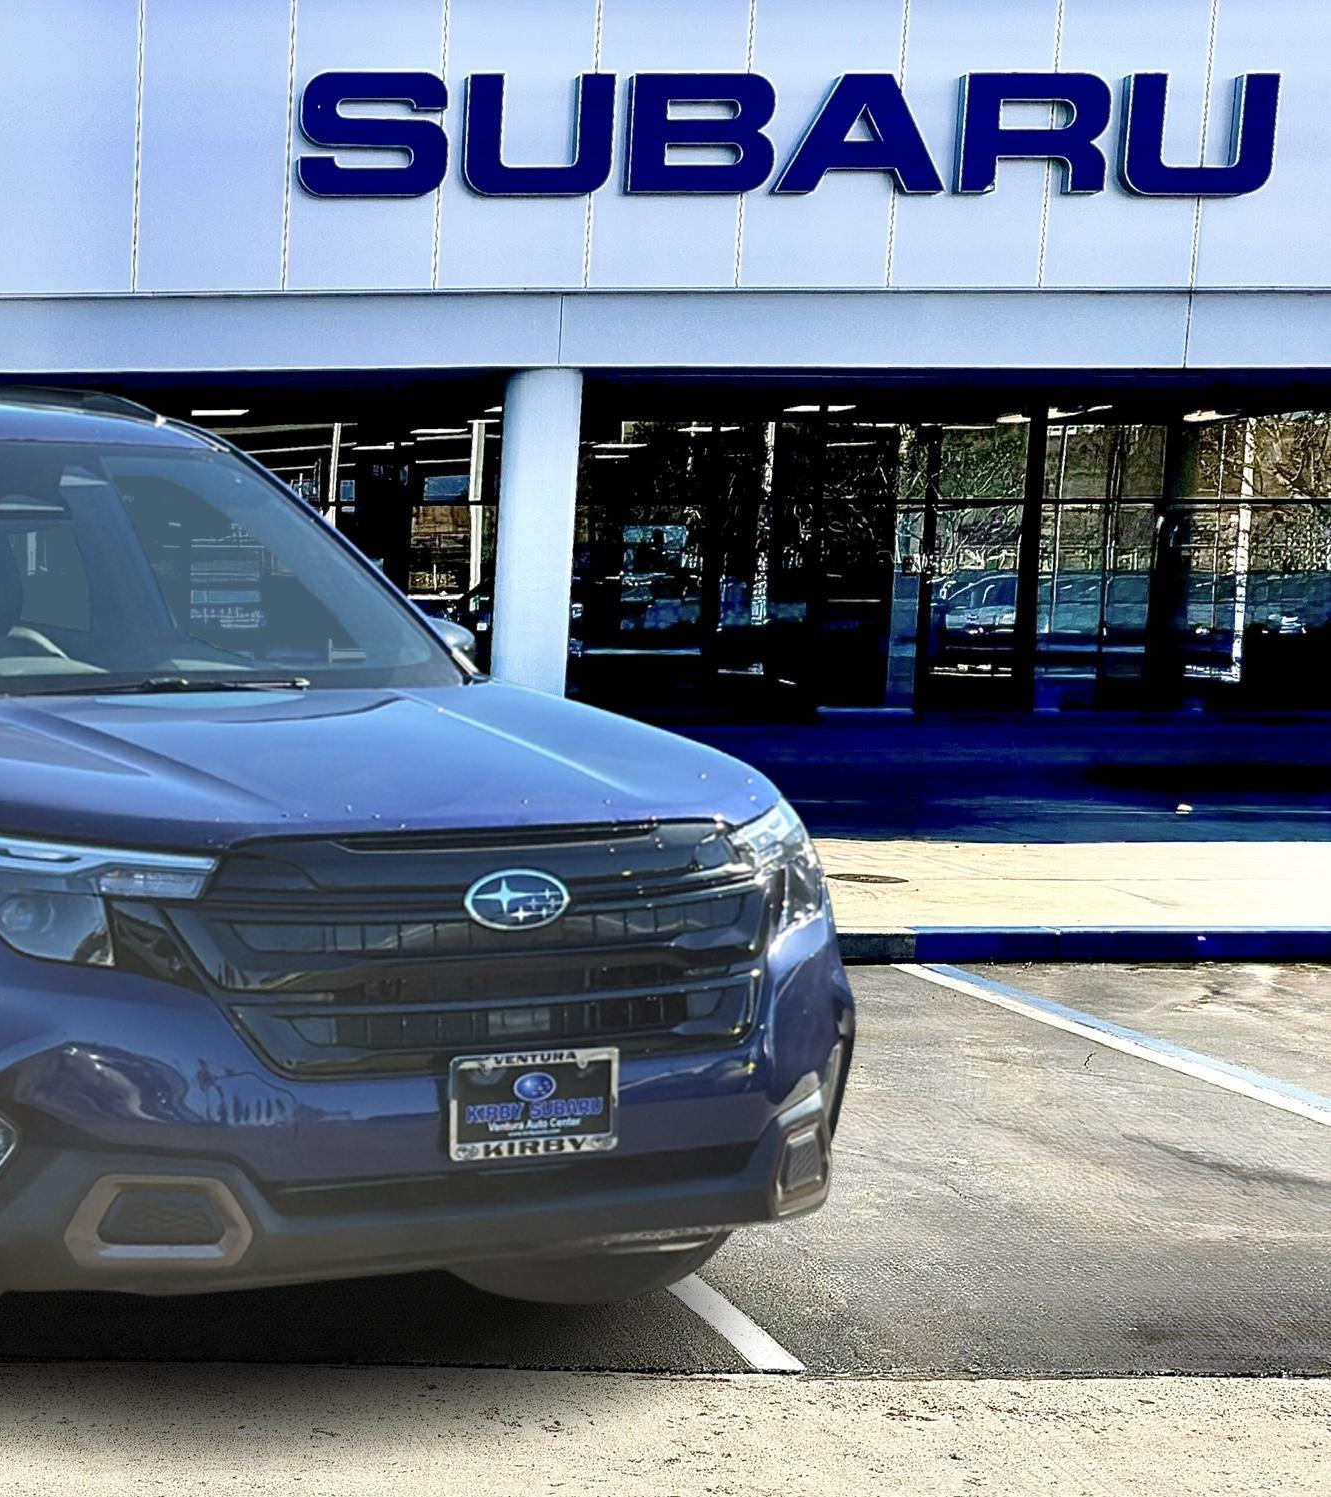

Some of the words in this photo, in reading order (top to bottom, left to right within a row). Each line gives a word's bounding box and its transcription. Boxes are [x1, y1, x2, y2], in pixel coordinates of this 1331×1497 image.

[296, 70, 1282, 199] SUBARU
[493, 1051, 577, 1065] VENTURA
[466, 1102, 523, 1124] KIRBY
[529, 1097, 604, 1118] SUBARU
[488, 1120, 524, 1132] Ventura
[526, 1119, 548, 1129] Auto
[550, 1117, 581, 1127] Center
[483, 1137, 587, 1157] KIRBY
